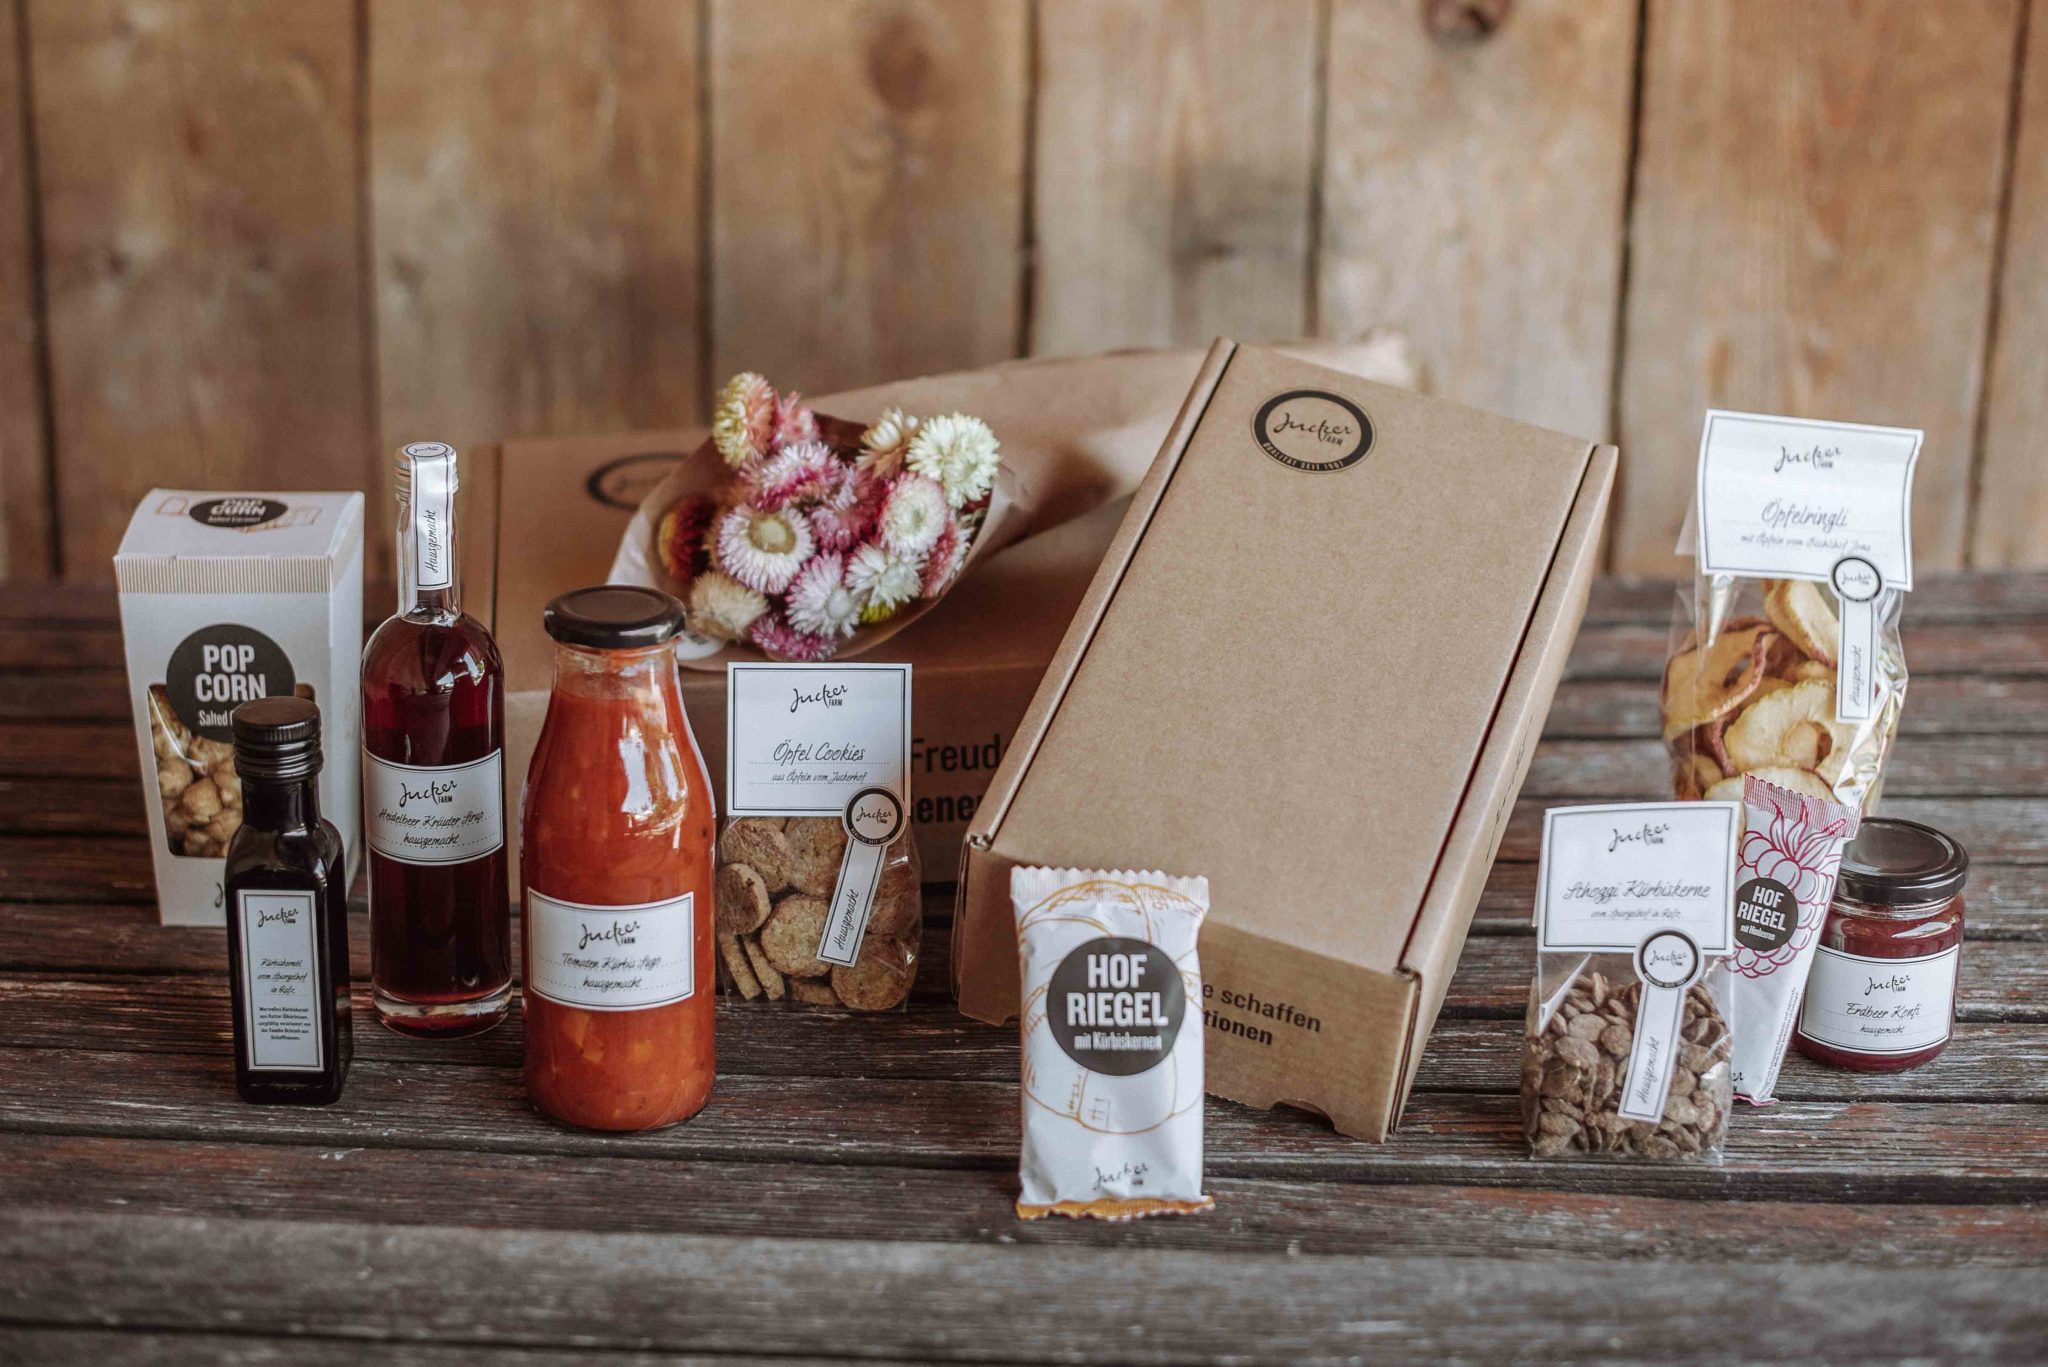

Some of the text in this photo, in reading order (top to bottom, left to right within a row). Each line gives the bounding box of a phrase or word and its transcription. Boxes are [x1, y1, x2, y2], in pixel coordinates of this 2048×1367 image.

[1273, 412, 1352, 442] Jucker
[1761, 497, 1849, 534] Öpfelringli
[424, 510, 442, 574] Hausgemacht
[203, 644, 256, 673] POP
[195, 673, 267, 703] CORN
[790, 683, 849, 713] Jucker
[828, 698, 843, 707] FARM
[199, 709, 228, 727] Salted
[773, 739, 866, 767] Öpfel Cookies
[911, 734, 1000, 773] Freud
[399, 780, 458, 808] Jucker
[379, 808, 420, 826] Heidelbeer
[422, 815, 461, 827] Kräuter
[403, 832, 460, 850] hausgemacht
[1608, 823, 1671, 852] Jucker
[1622, 878, 1711, 899] Kürbiskerne
[1752, 885, 1785, 909] HOF
[258, 907, 299, 928] Jucker
[834, 889, 859, 950] Hausgemacht
[1736, 900, 1787, 932] RIEGEL
[579, 920, 641, 950] Jucker
[562, 953, 599, 968] Tomaten
[1087, 953, 1148, 989] HOF
[582, 976, 642, 993] hausgemacht
[1864, 975, 1911, 996] Jucker
[1066, 992, 1169, 1028] RIEGEL
[1220, 992, 1321, 1033] schaffen
[1847, 1002, 1920, 1020] Erdbeer Konfi
[1203, 1009, 1273, 1046] tionen
[1635, 1036, 1660, 1104] Hausgemacht
